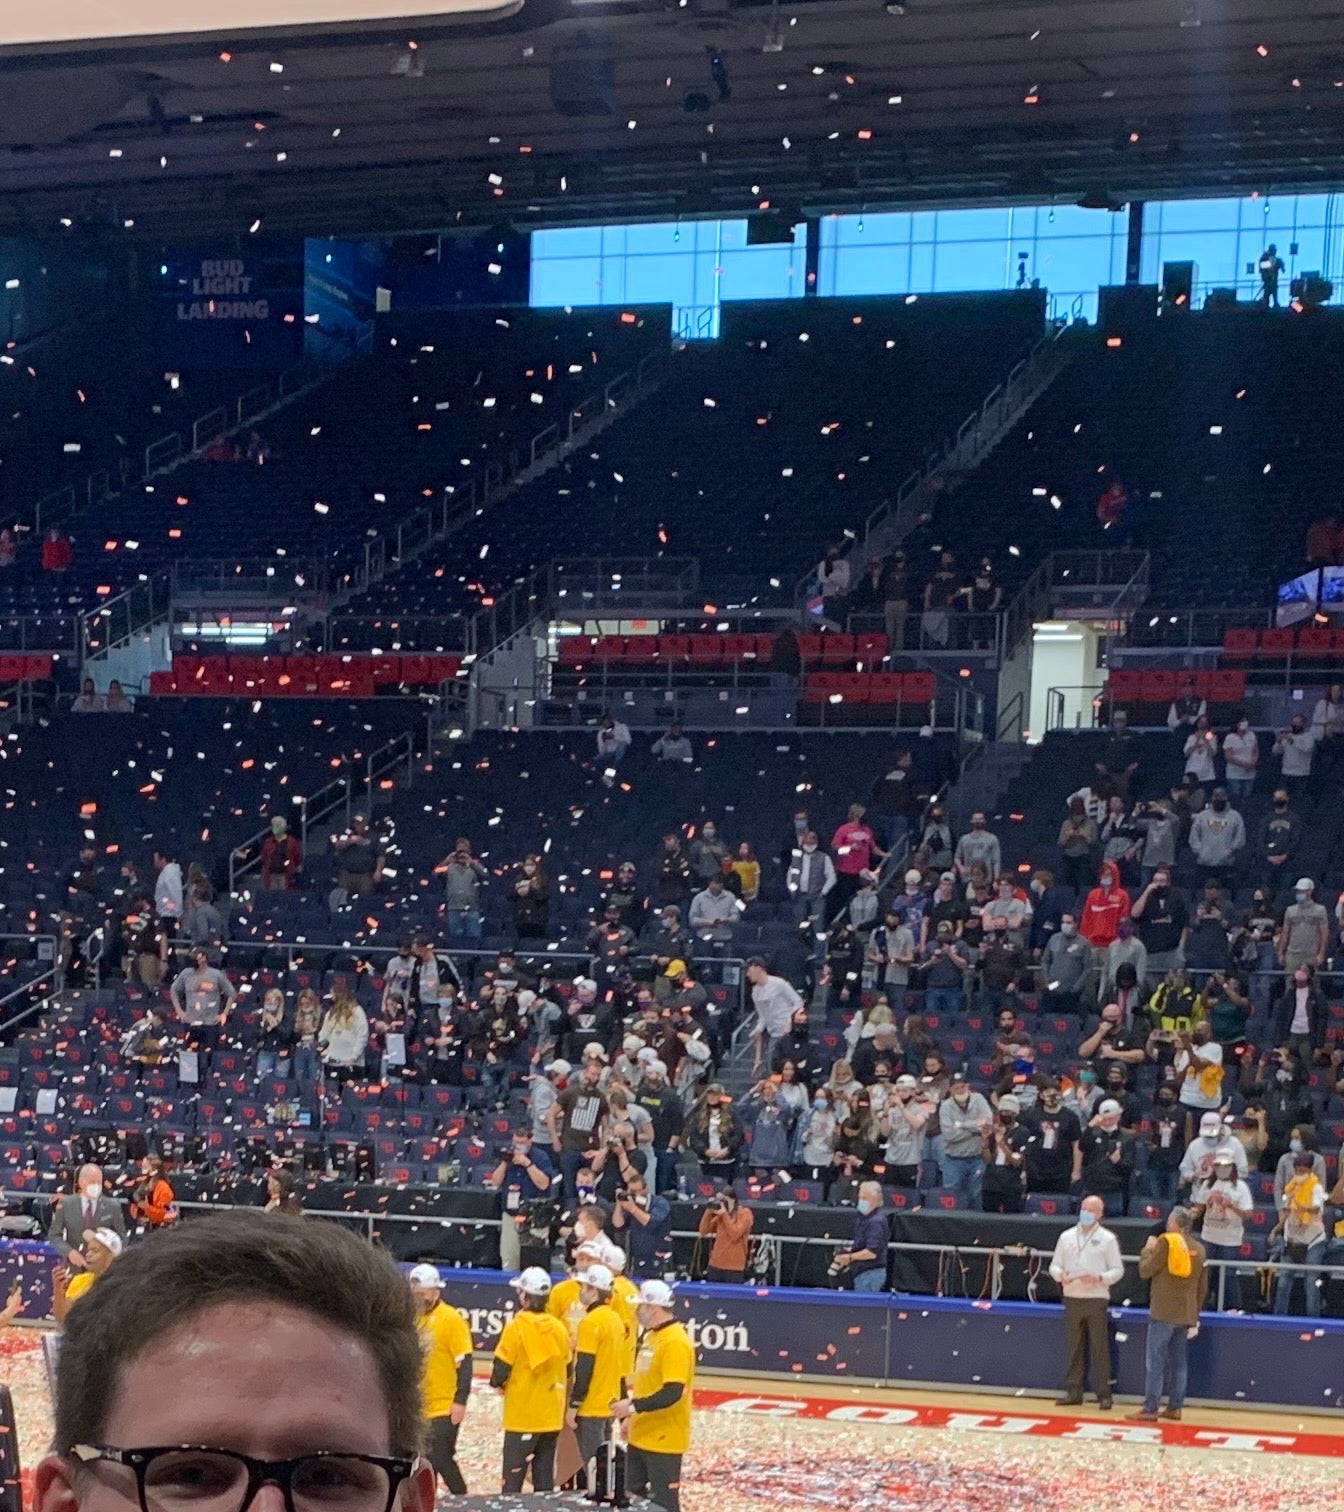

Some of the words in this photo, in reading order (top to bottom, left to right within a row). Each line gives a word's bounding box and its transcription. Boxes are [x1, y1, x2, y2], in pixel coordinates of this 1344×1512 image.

[201, 259, 244, 277] BUD
[192, 276, 253, 296] LIGHT
[177, 300, 269, 320] LANDING
